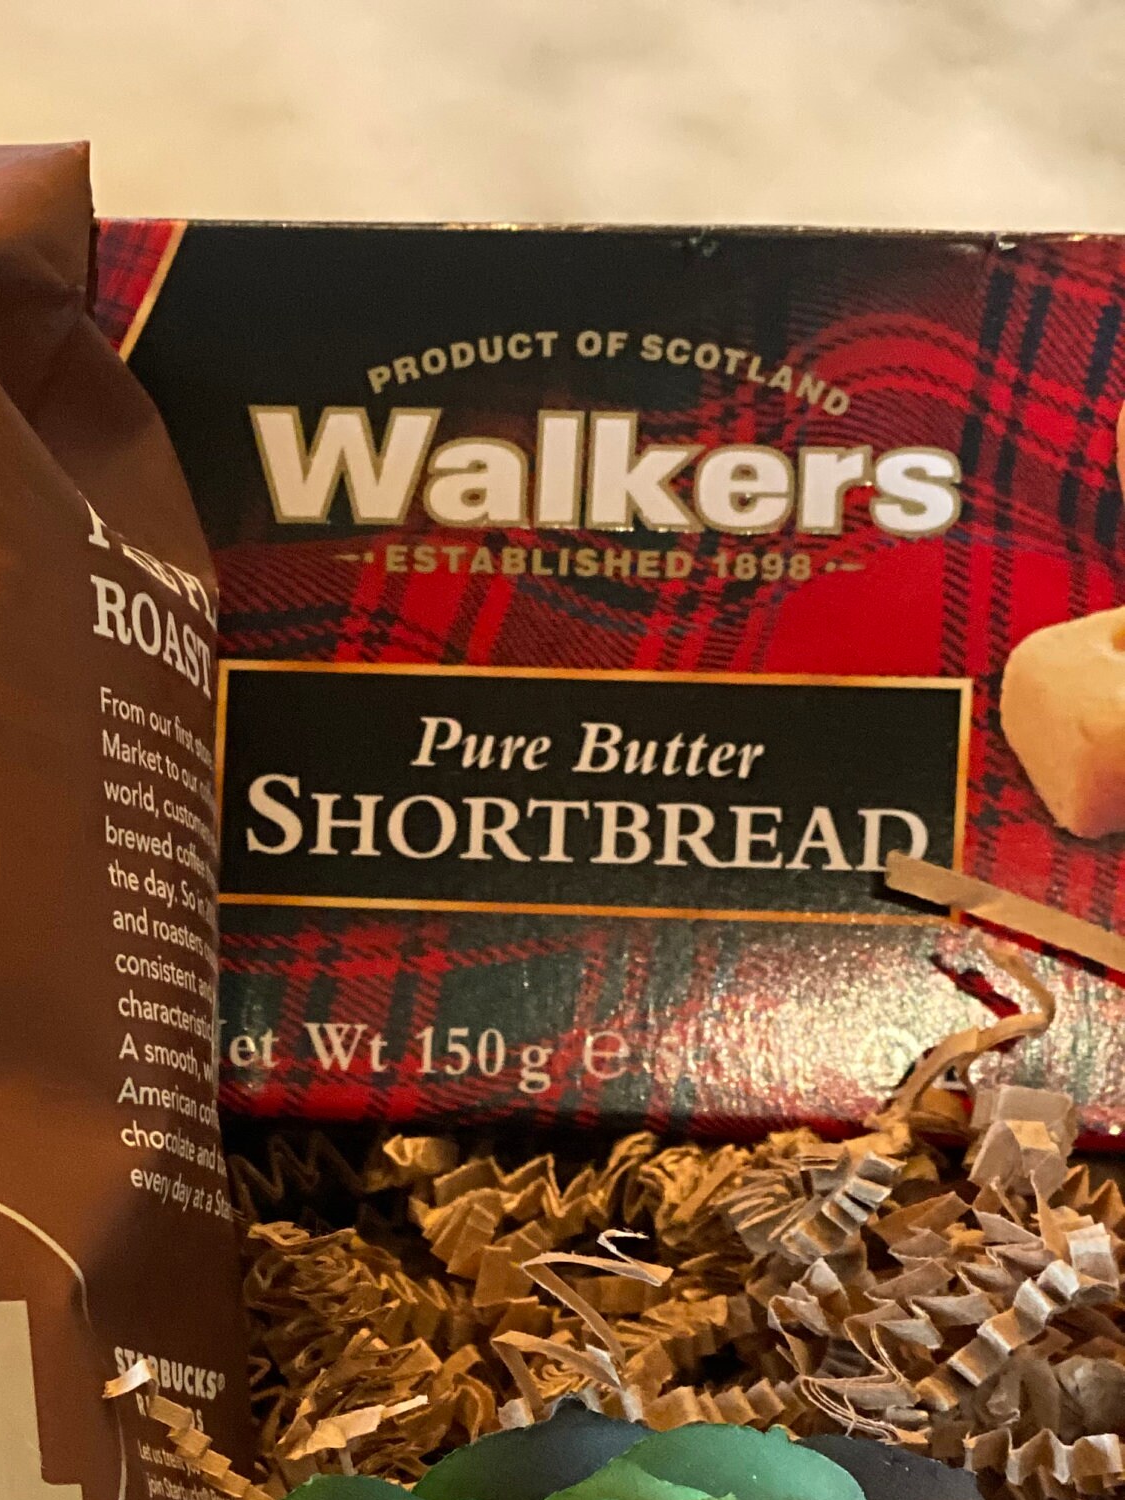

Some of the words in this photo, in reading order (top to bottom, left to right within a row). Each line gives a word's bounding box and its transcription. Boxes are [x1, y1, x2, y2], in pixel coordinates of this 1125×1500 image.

[366, 330, 559, 395] PRODUCT
[575, 330, 630, 359] OF
[639, 333, 851, 417] SCOTLAND
[248, 404, 963, 538] Walkers
[384, 544, 693, 581] ESTABLISHED
[713, 552, 812, 582] 1898
[90, 574, 211, 700] ROAST
[99, 686, 146, 726] From
[149, 710, 172, 738] our
[174, 715, 194, 753] first
[102, 729, 164, 776] Market
[165, 755, 180, 782] to
[181, 766, 198, 794] our
[410, 716, 552, 774] Pure
[572, 720, 765, 779] Butter
[103, 779, 160, 819] world,
[245, 772, 930, 873] SHORTBREAD
[105, 815, 173, 860] brewed
[107, 859, 140, 893] the
[144, 868, 178, 909] day.
[180, 880, 196, 911] So
[112, 906, 149, 936] and
[152, 920, 204, 957] roasters
[114, 952, 197, 993] consistent
[118, 1032, 140, 1063] A
[144, 1043, 201, 1083] smooth,
[219, 1018, 280, 1072] et
[305, 1021, 390, 1074] Wt
[414, 1025, 506, 1078] 150
[517, 1042, 553, 1094] g
[117, 1076, 197, 1120] American
[120, 1119, 195, 1163] chocolate
[197, 1143, 216, 1170] and
[130, 1167, 172, 1205] every
[172, 1172, 193, 1213] day
[193, 1186, 205, 1210] at
[205, 1193, 213, 1213] a
